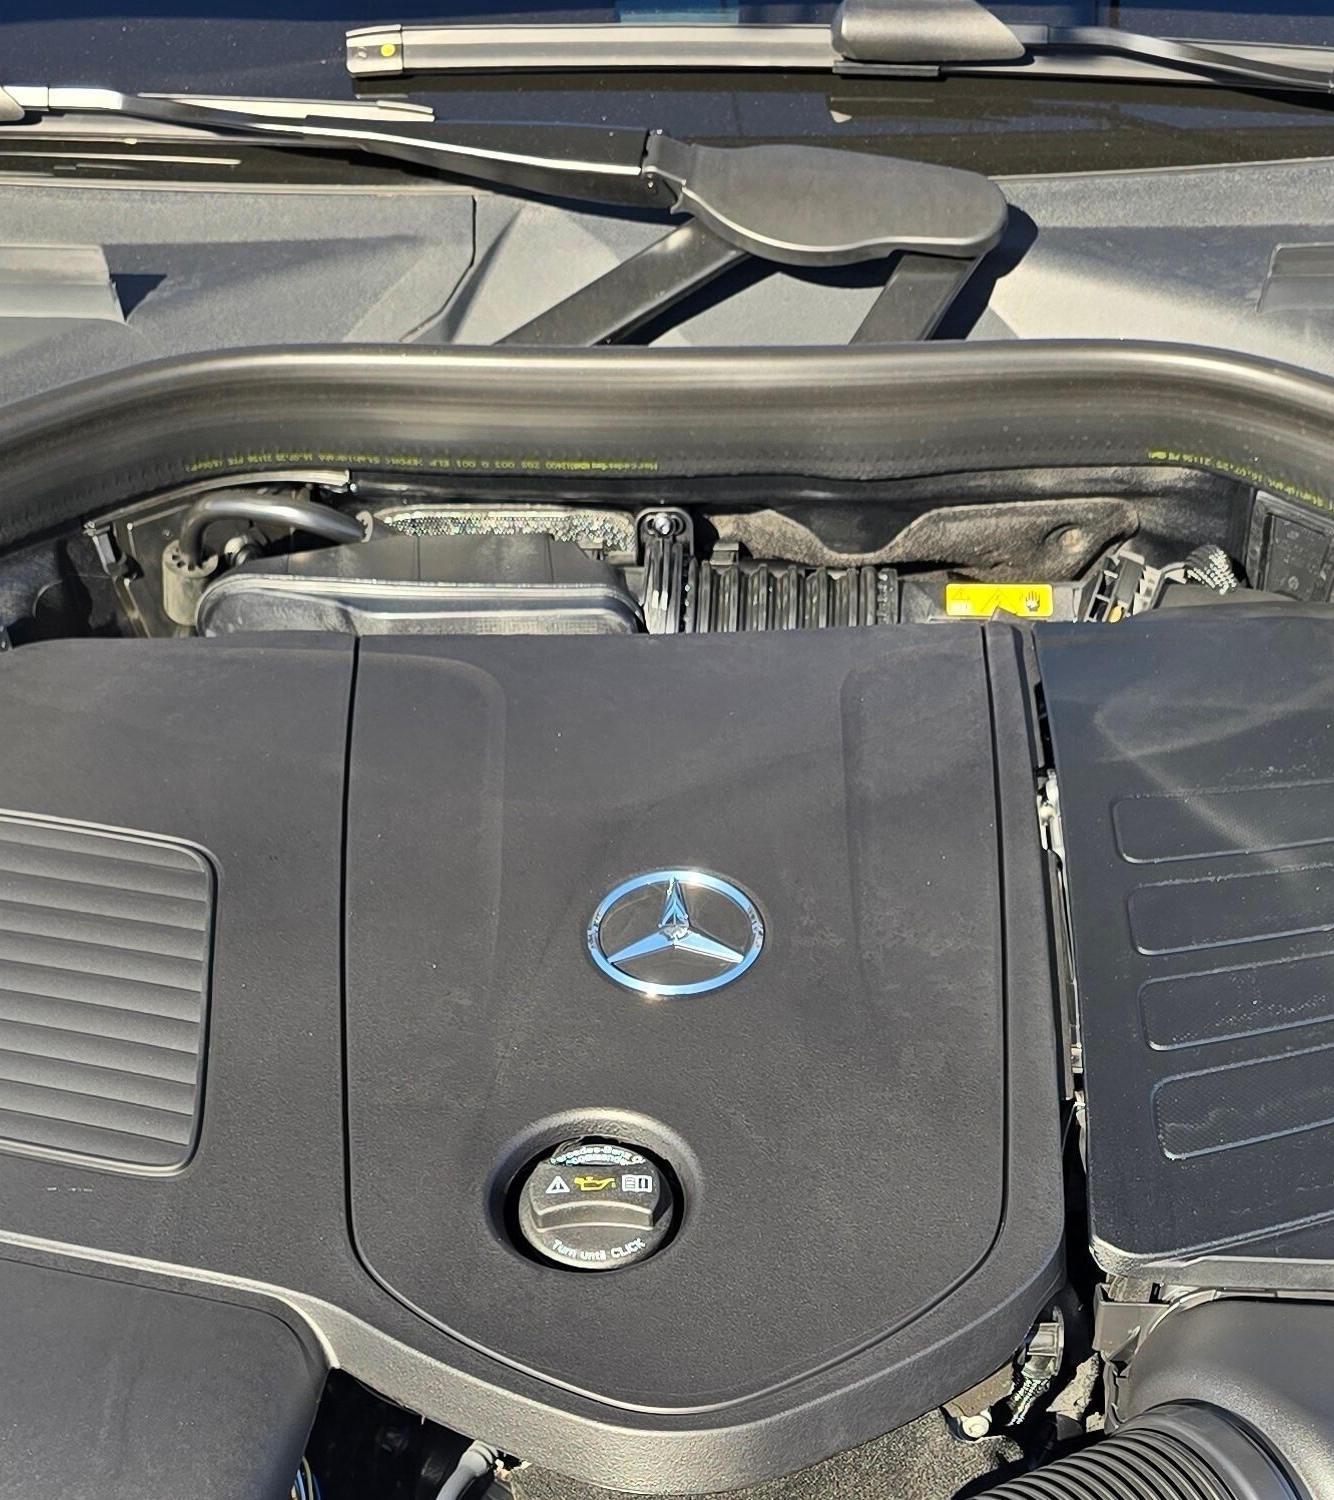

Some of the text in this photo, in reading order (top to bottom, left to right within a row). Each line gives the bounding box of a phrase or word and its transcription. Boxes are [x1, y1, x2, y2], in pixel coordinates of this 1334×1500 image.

[552, 1238, 646, 1261] Turn until CLICK
